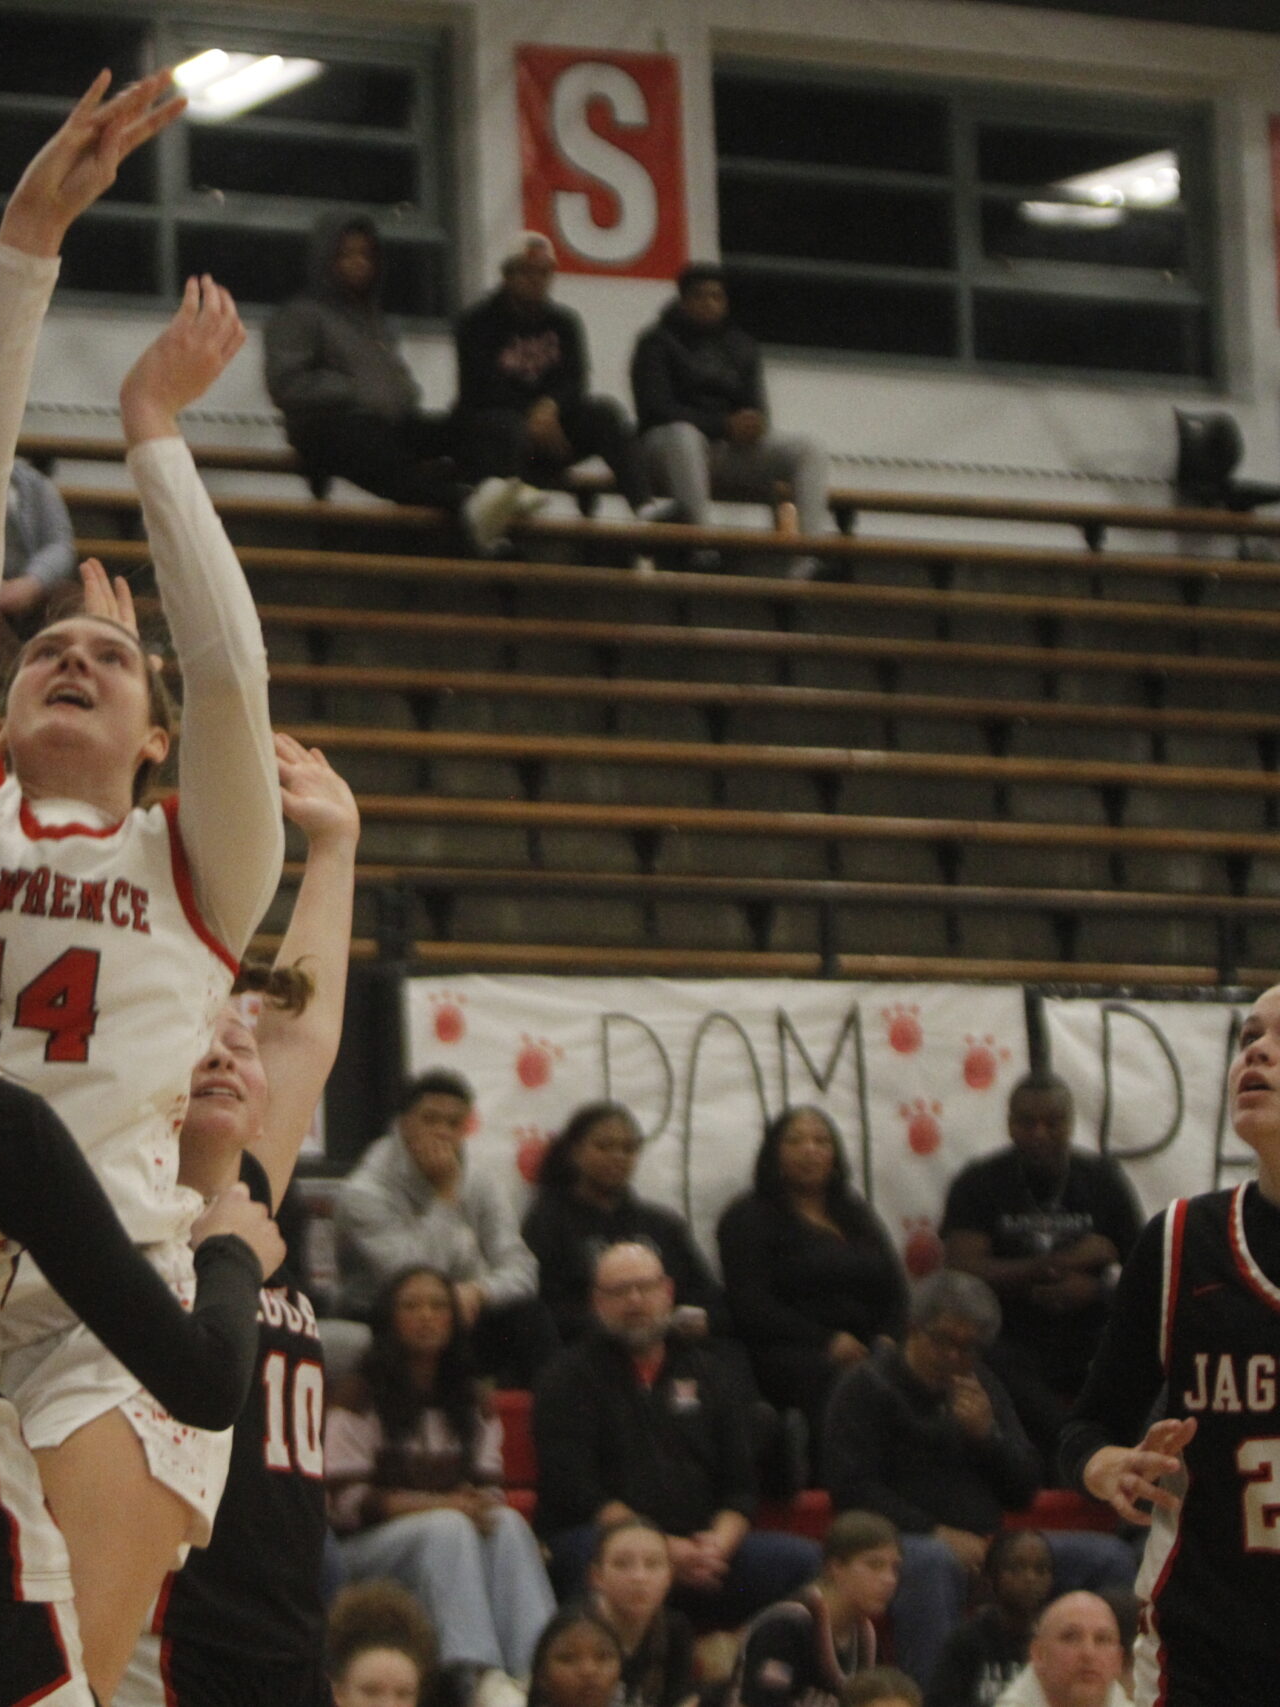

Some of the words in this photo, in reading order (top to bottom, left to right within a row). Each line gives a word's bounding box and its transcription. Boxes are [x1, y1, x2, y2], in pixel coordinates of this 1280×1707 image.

[551, 60, 658, 264] S
[263, 1350, 324, 1479] 10
[1183, 1352, 1276, 1412] JAG
[1236, 1436, 1280, 1555] 2
